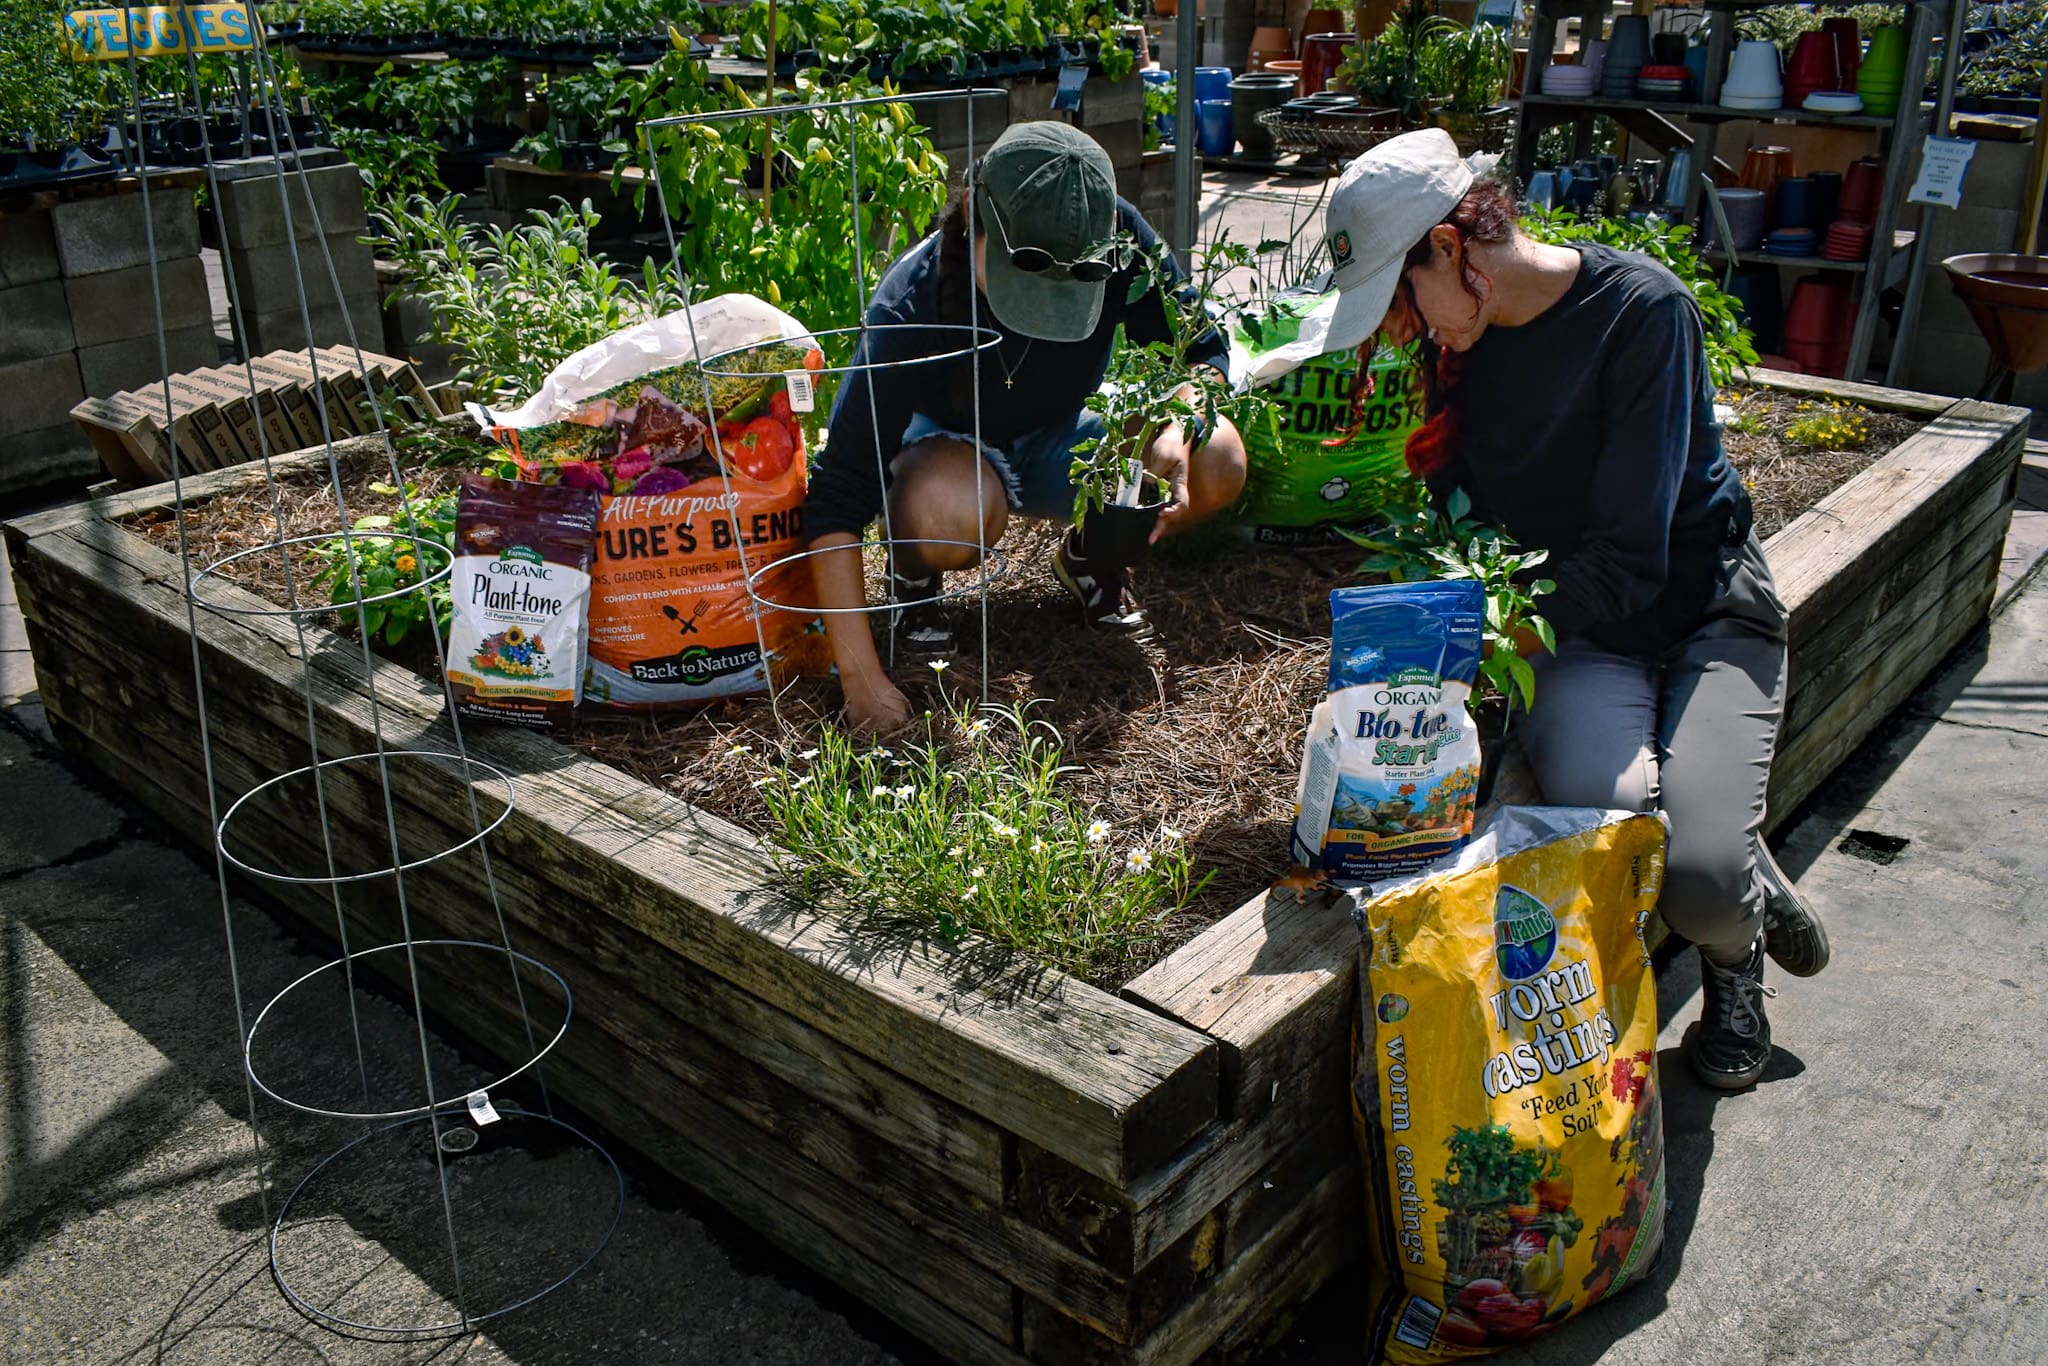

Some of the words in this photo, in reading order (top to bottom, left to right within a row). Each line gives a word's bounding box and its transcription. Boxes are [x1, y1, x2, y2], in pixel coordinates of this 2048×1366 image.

[64, 9, 254, 53] VEGGIES
[1263, 366, 1377, 398] OTTO
[1278, 401, 1418, 433] COMOST
[603, 491, 741, 526] All-Purpose
[711, 507, 801, 549] BLEND
[489, 561, 553, 580] ORGANIC
[614, 568, 666, 584] GARDENS,
[669, 564, 722, 577] FLOWERS,
[472, 573, 562, 616] Plant-tone
[603, 592, 641, 603] COMPOST
[643, 590, 669, 600] BLEND
[670, 586, 692, 596] WITH
[693, 582, 726, 593] ALFALFA
[493, 613, 514, 621] Purpose
[515, 614, 530, 622] Plant
[530, 616, 545, 624] Food
[595, 625, 632, 634] IMPROVES
[633, 663, 678, 680] Back
[681, 663, 696, 674] to
[698, 649, 758, 672] Nature
[1397, 673, 1434, 683] Espoma
[479, 687, 512, 695] ORGANIC
[513, 688, 557, 698] GARDENING
[1374, 690, 1442, 706] ORGAN
[1354, 707, 1449, 740] Bio-toe
[1384, 769, 1408, 778] Starter
[1345, 832, 1365, 841] FOR
[1371, 836, 1413, 849] ORGANIC
[1413, 830, 1457, 842] GARDENING
[1483, 1007, 1618, 1100] castings
[1386, 1034, 1412, 1133] worm
[1582, 1072, 1609, 1100] Your
[1394, 1144, 1427, 1265] castings
